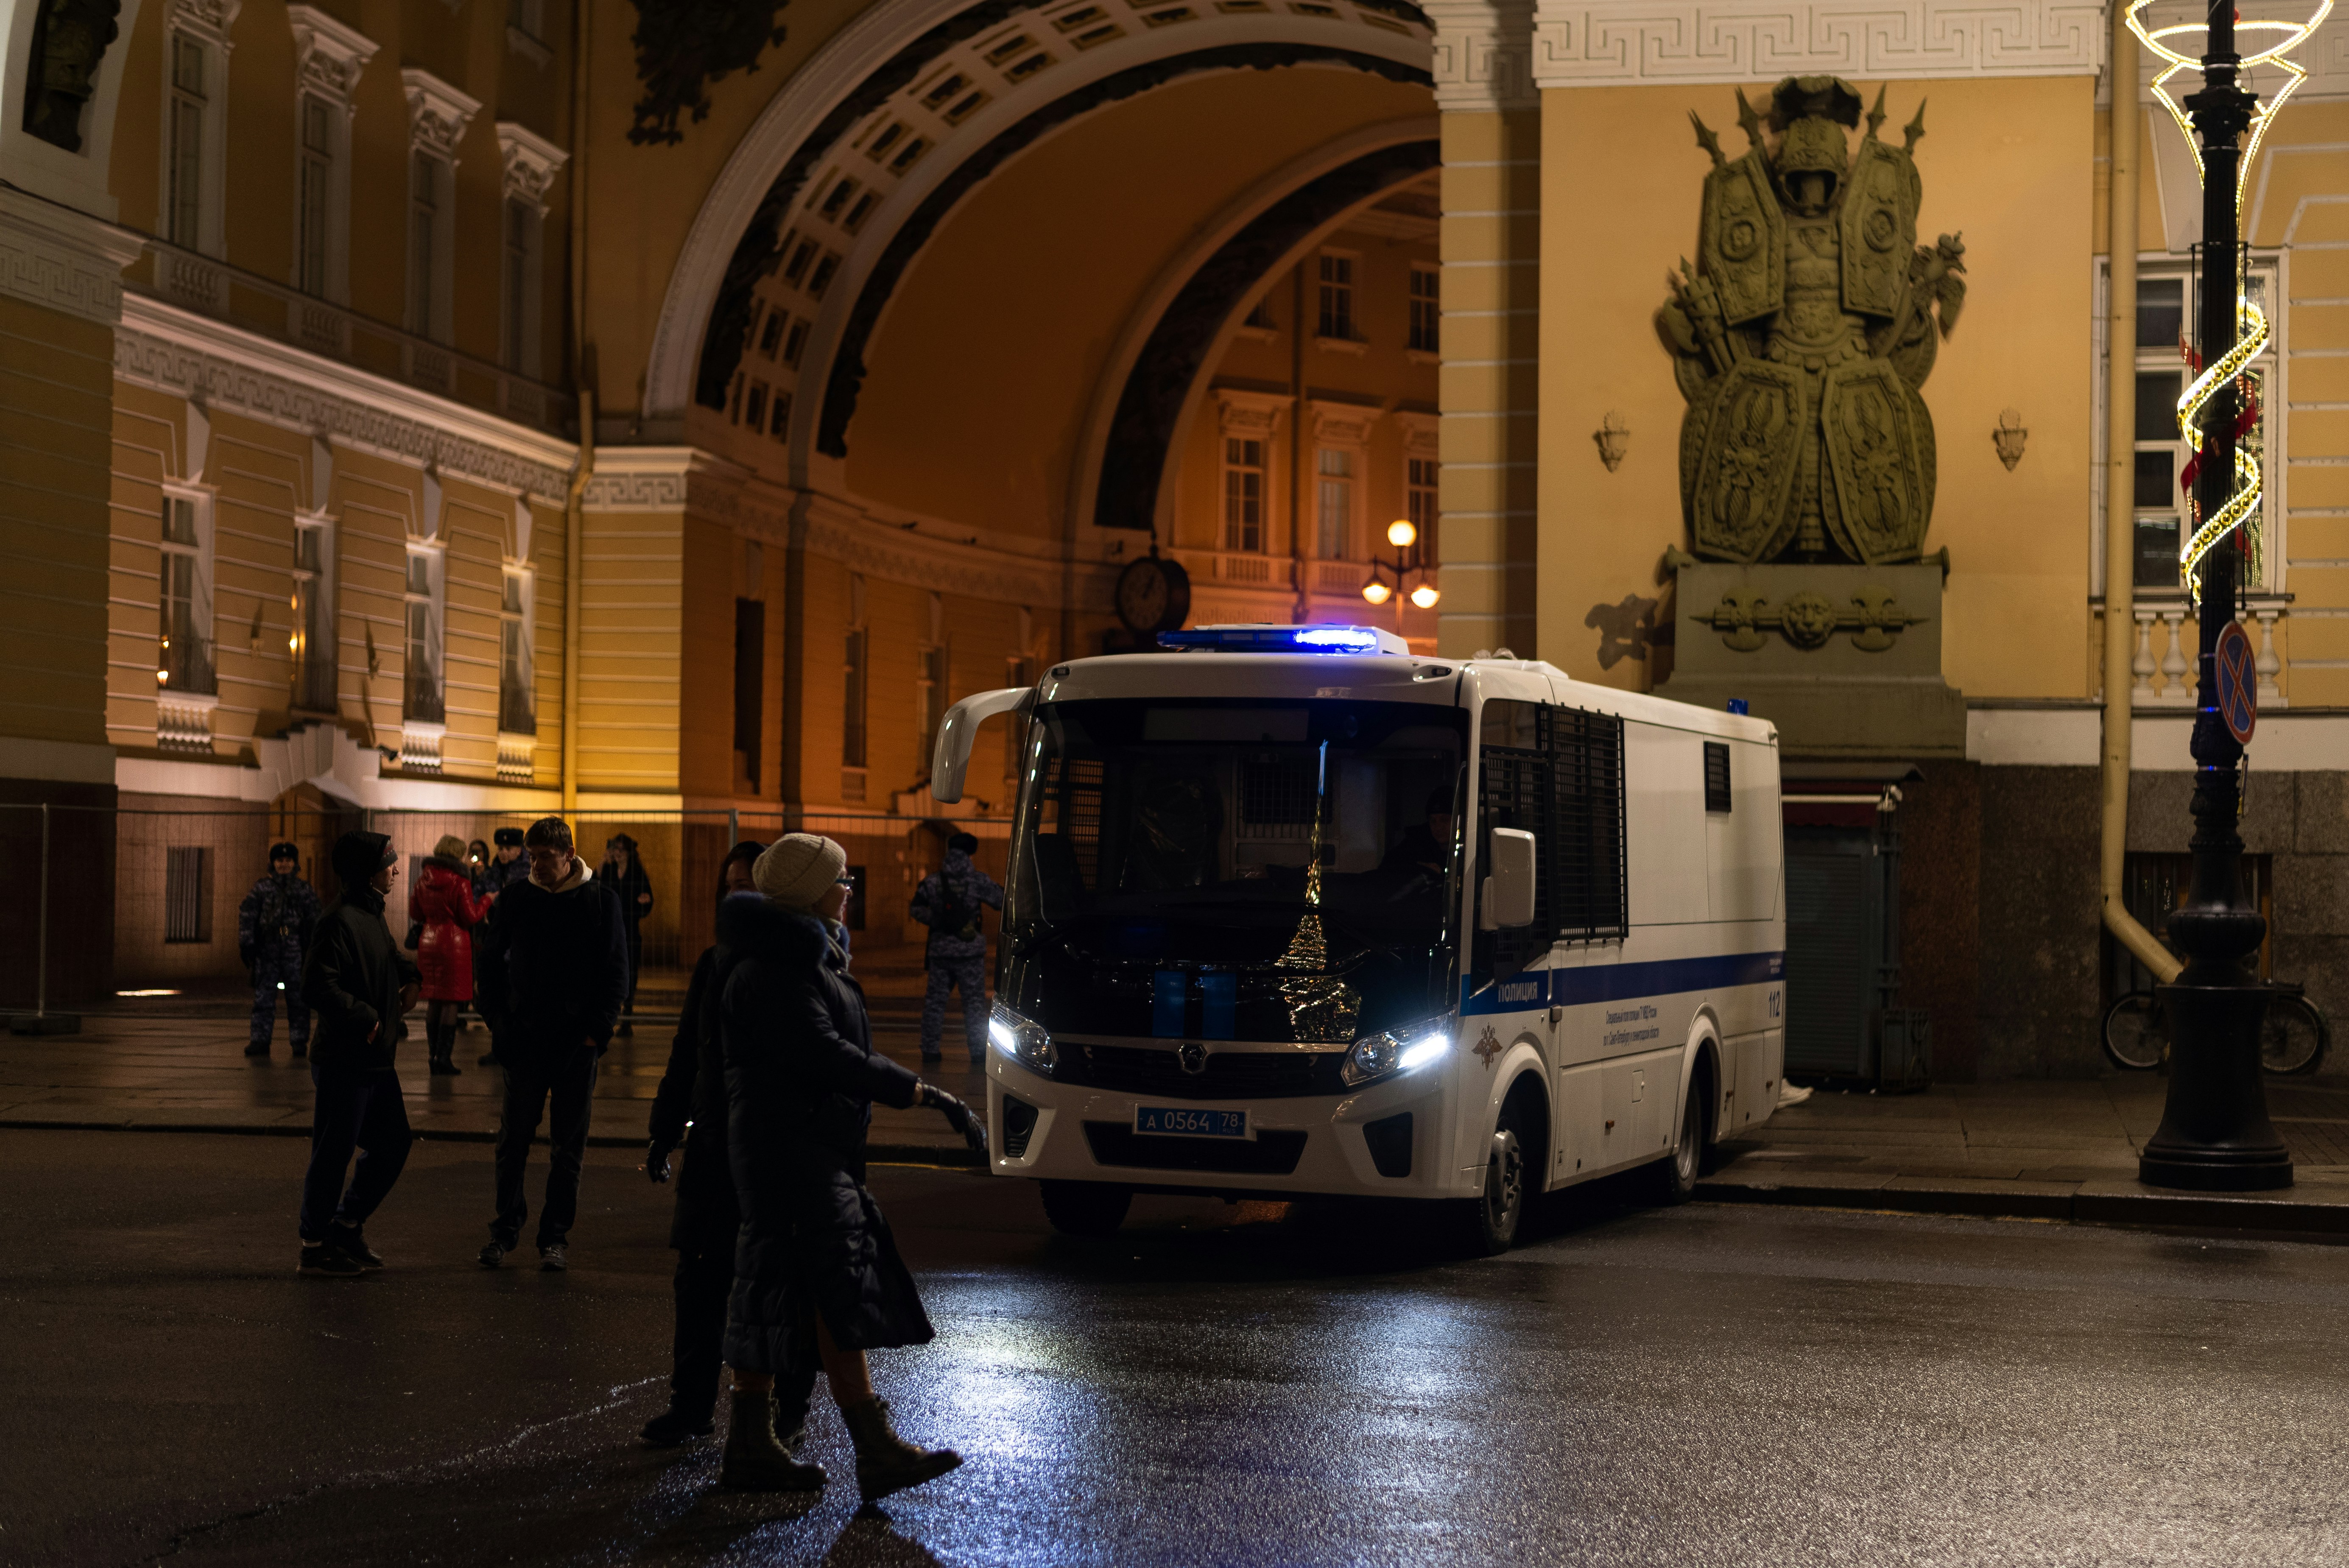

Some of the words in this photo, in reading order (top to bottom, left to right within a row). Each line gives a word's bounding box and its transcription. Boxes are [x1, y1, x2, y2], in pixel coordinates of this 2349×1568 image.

[1498, 982, 1537, 1002] ПОЛИЦИЯ
[1769, 990, 1780, 1018] 112
[1165, 1112, 1209, 1131] 0564
[1221, 1113, 1238, 1127] 78
